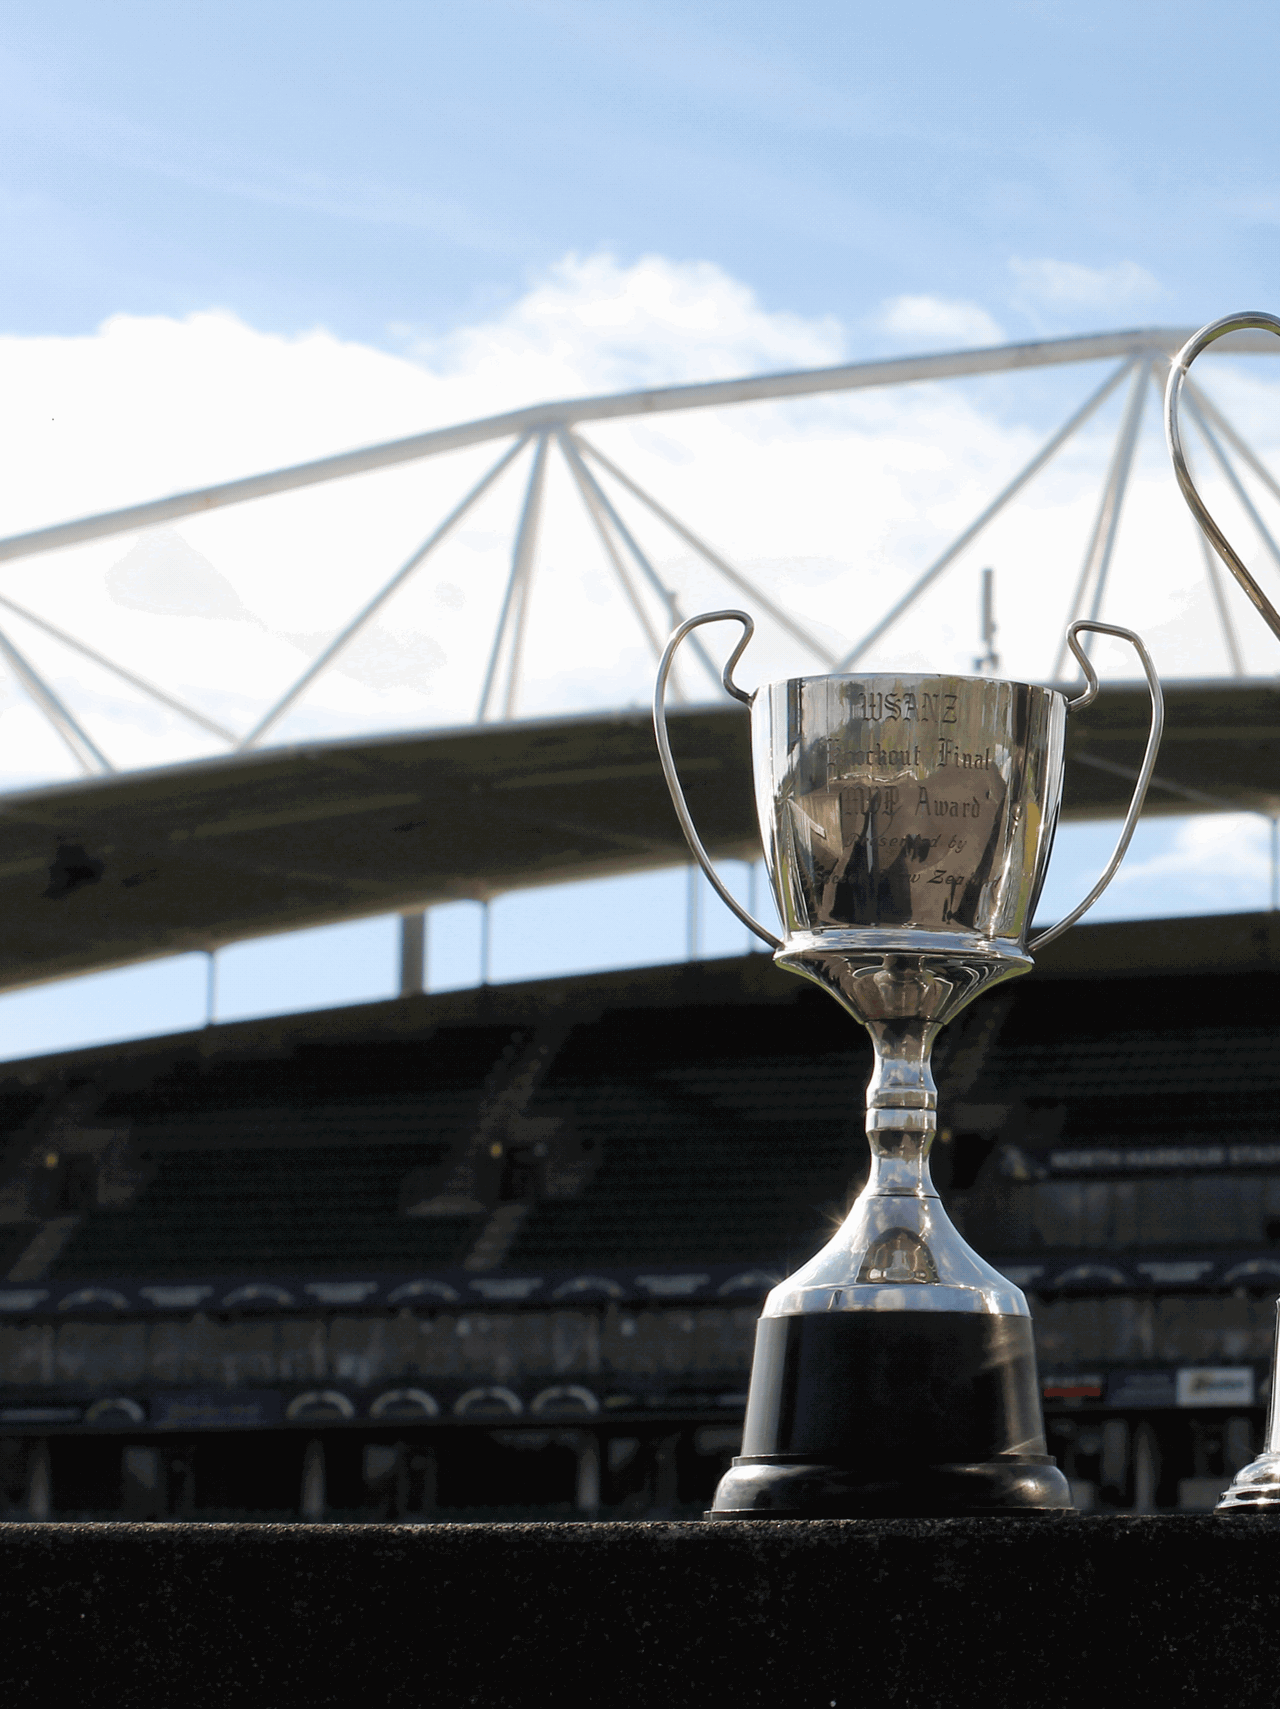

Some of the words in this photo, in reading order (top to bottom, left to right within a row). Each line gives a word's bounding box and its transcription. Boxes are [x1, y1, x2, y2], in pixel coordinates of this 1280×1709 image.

[936, 738, 990, 771] Final
[915, 786, 981, 818] Award
[947, 835, 968, 853] by
